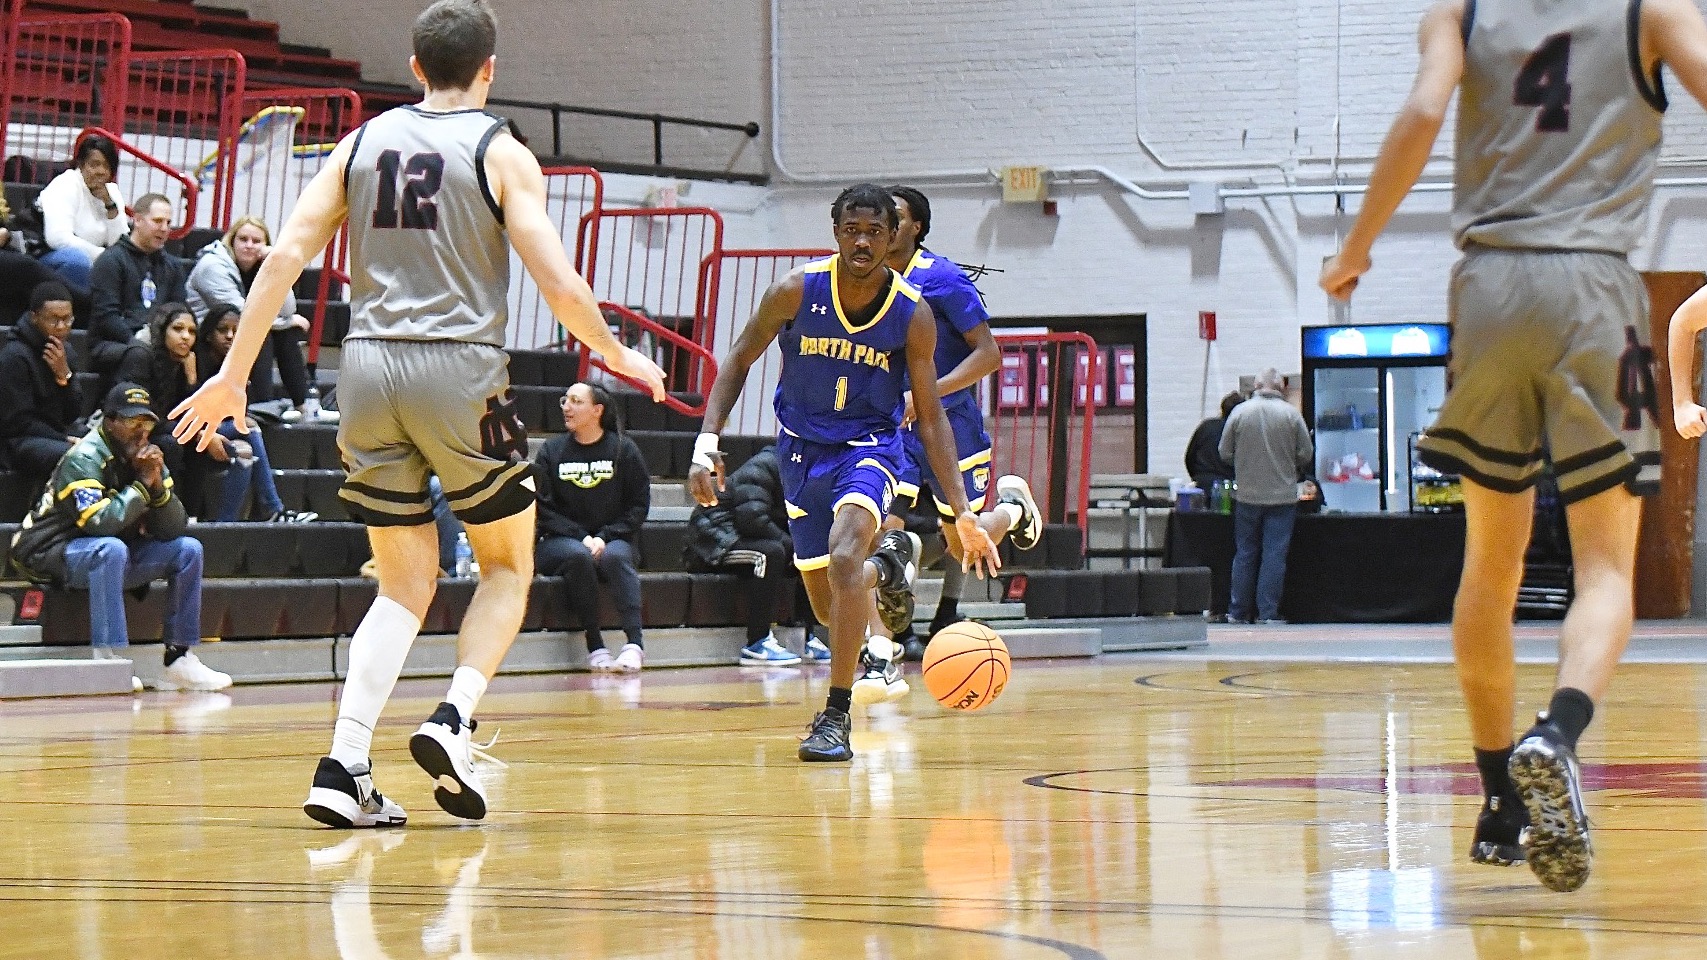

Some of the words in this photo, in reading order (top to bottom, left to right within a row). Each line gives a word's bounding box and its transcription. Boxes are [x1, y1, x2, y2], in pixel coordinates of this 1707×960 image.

[1512, 31, 1571, 132] 4
[372, 148, 445, 231] 12
[1010, 167, 1037, 192] EXIT
[799, 335, 853, 361] NORTH
[834, 376, 848, 412] 1
[590, 460, 613, 473] PARK
